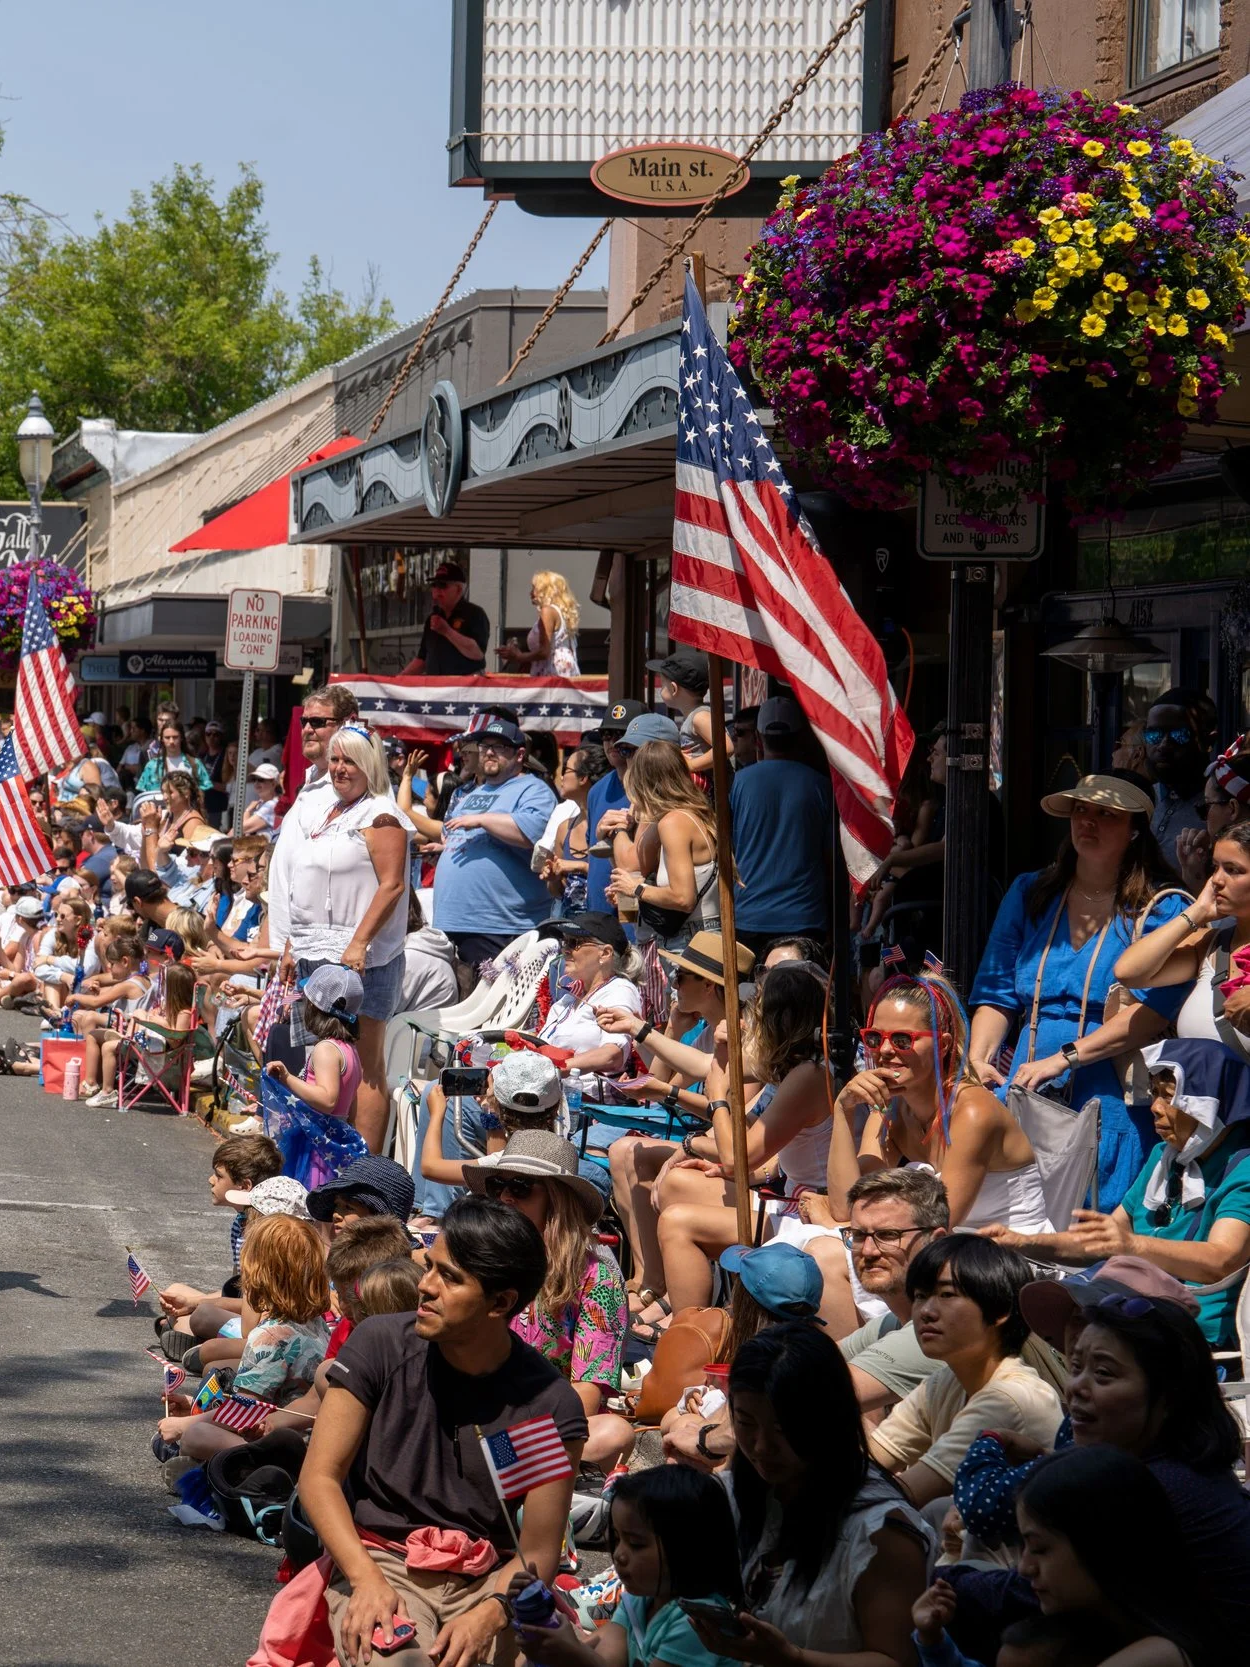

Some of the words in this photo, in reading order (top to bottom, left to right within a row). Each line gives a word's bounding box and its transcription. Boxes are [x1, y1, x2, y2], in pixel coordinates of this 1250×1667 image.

[628, 157, 682, 177] Main
[688, 159, 714, 177] st.
[942, 532, 964, 545] AND
[969, 532, 1019, 545] HOLIDAYS
[246, 596, 265, 612] NO
[231, 613, 278, 631] PARKING
[233, 631, 273, 645] LOADING
[239, 643, 266, 656] ZONE
[144, 653, 209, 666] Alexander's
